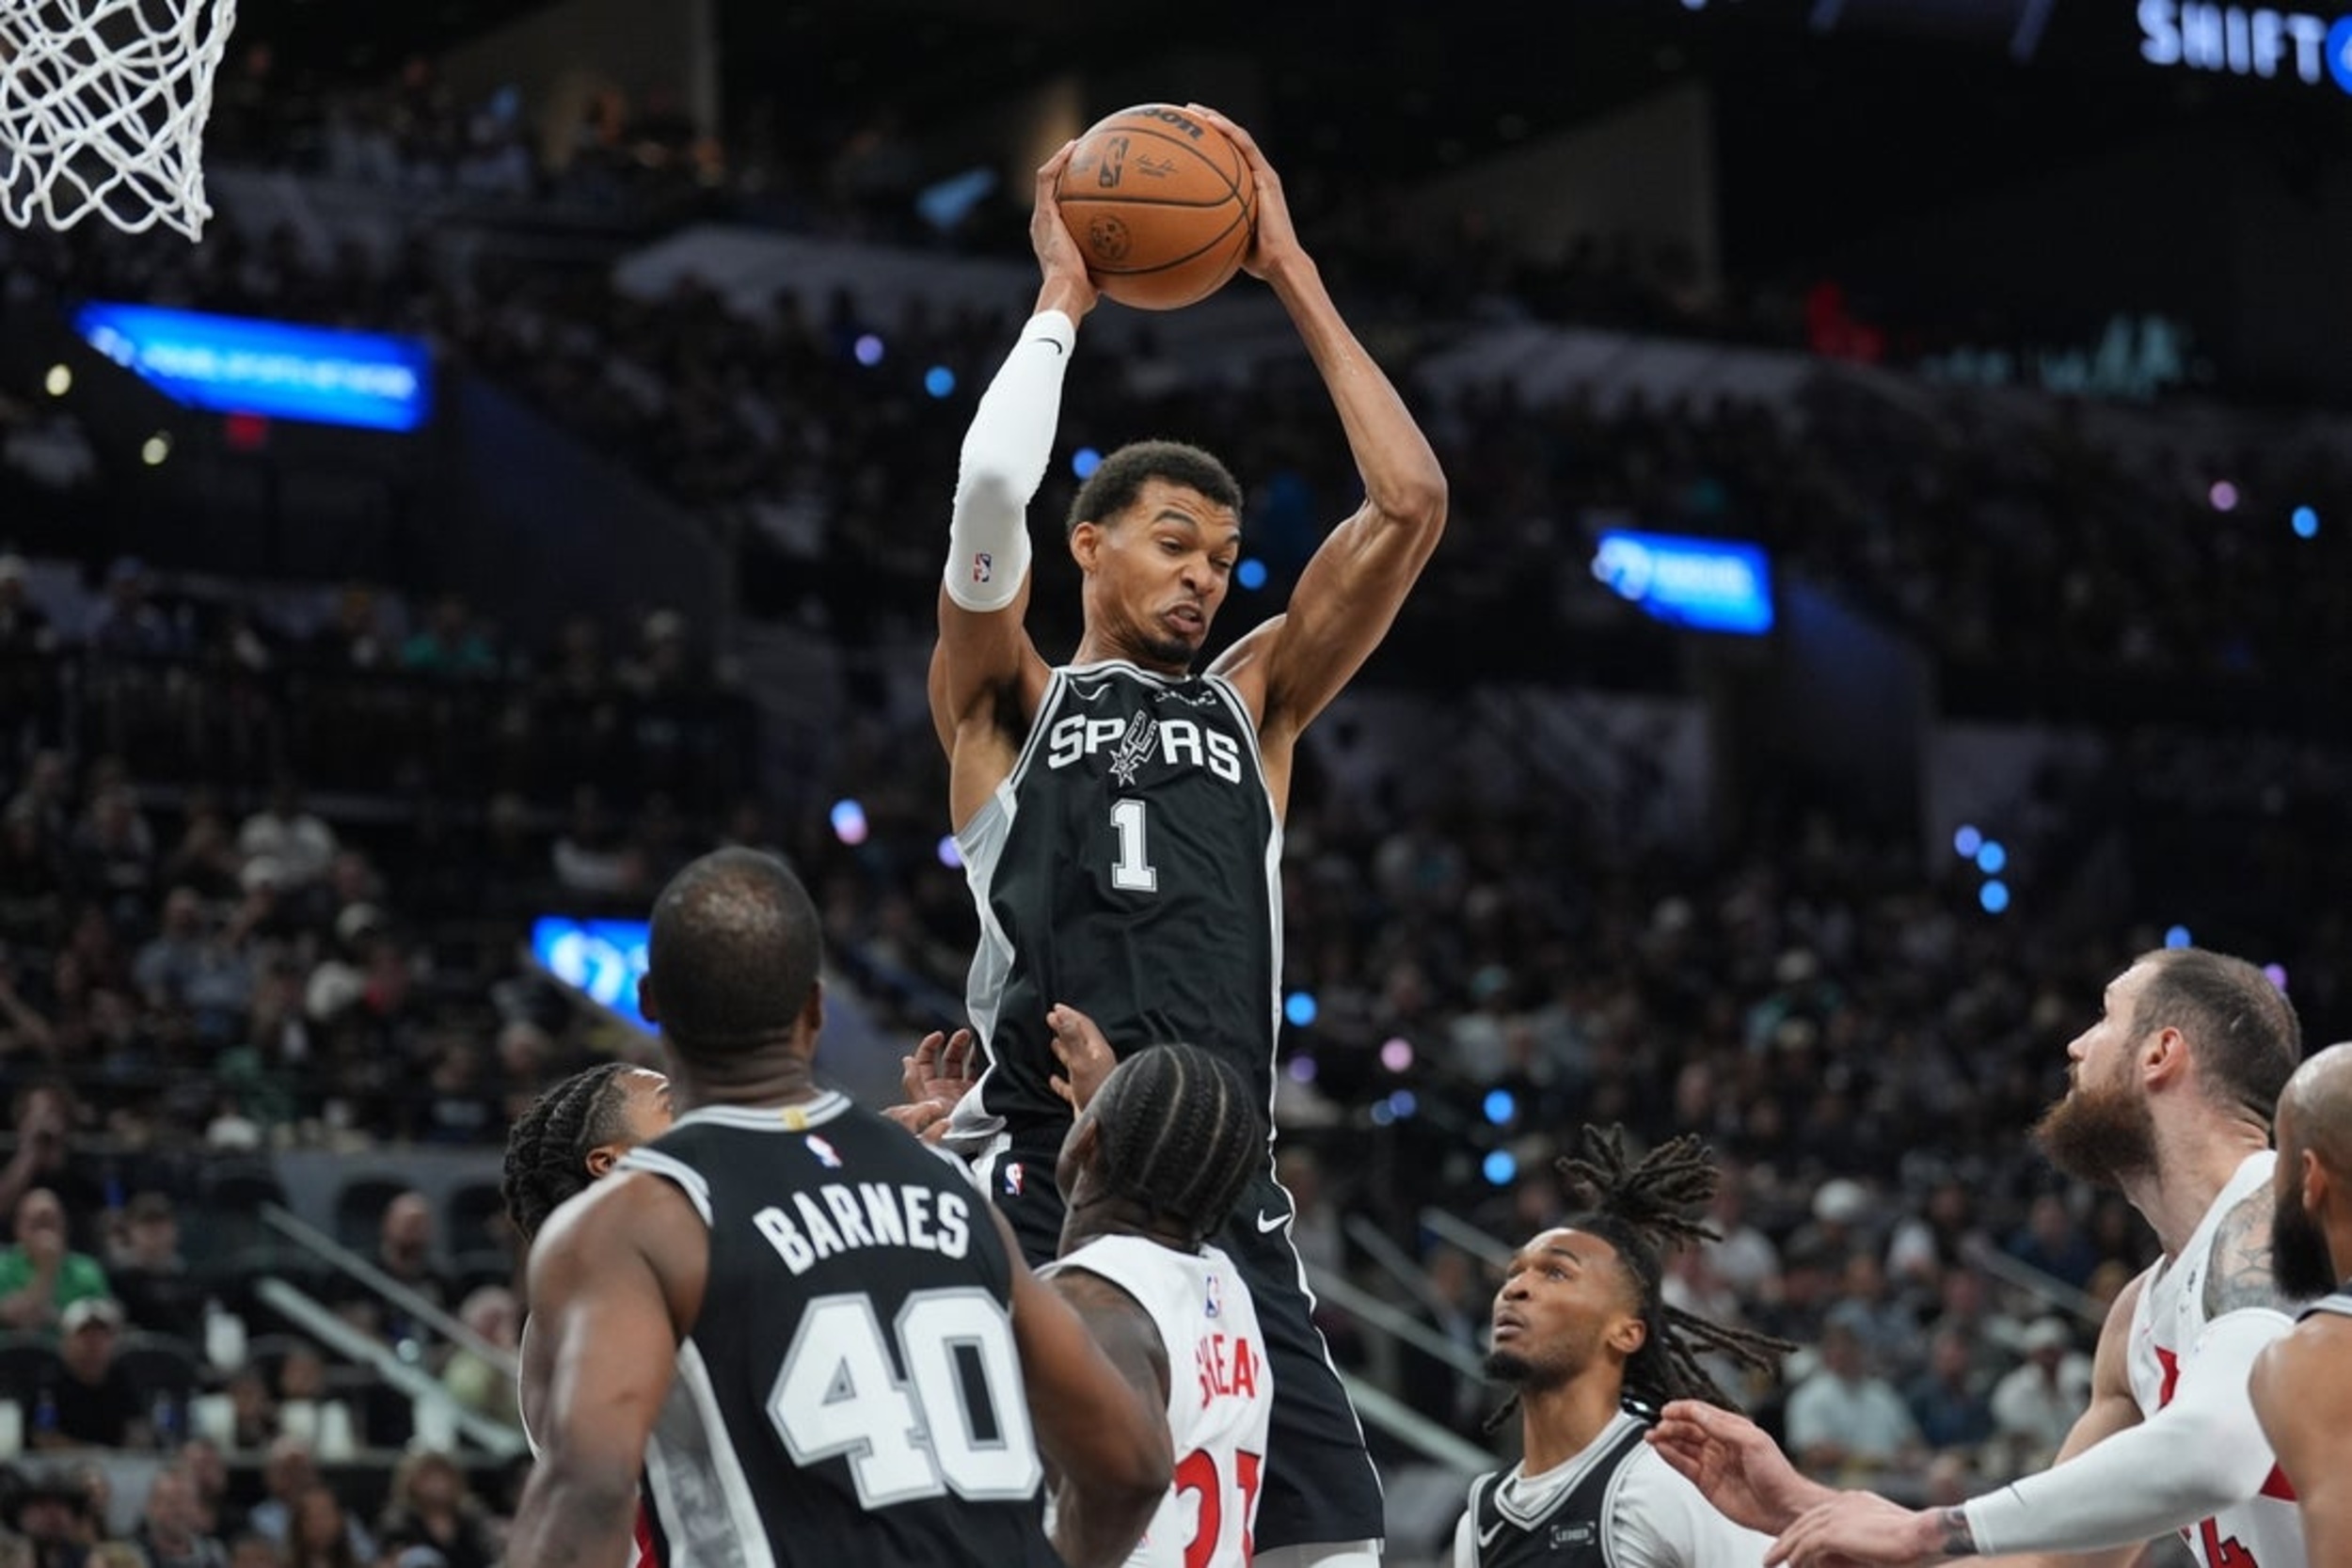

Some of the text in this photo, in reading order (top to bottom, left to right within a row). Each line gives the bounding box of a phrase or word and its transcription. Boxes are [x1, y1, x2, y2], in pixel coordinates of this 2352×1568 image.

[2137, 0, 2352, 95] SHIFT
[1047, 710, 1242, 786] SPURS
[1110, 798, 1157, 893] 1
[753, 1182, 970, 1276] BARNES
[766, 1287, 1044, 1511] 40
[1195, 1334, 1261, 1410] SHEA
